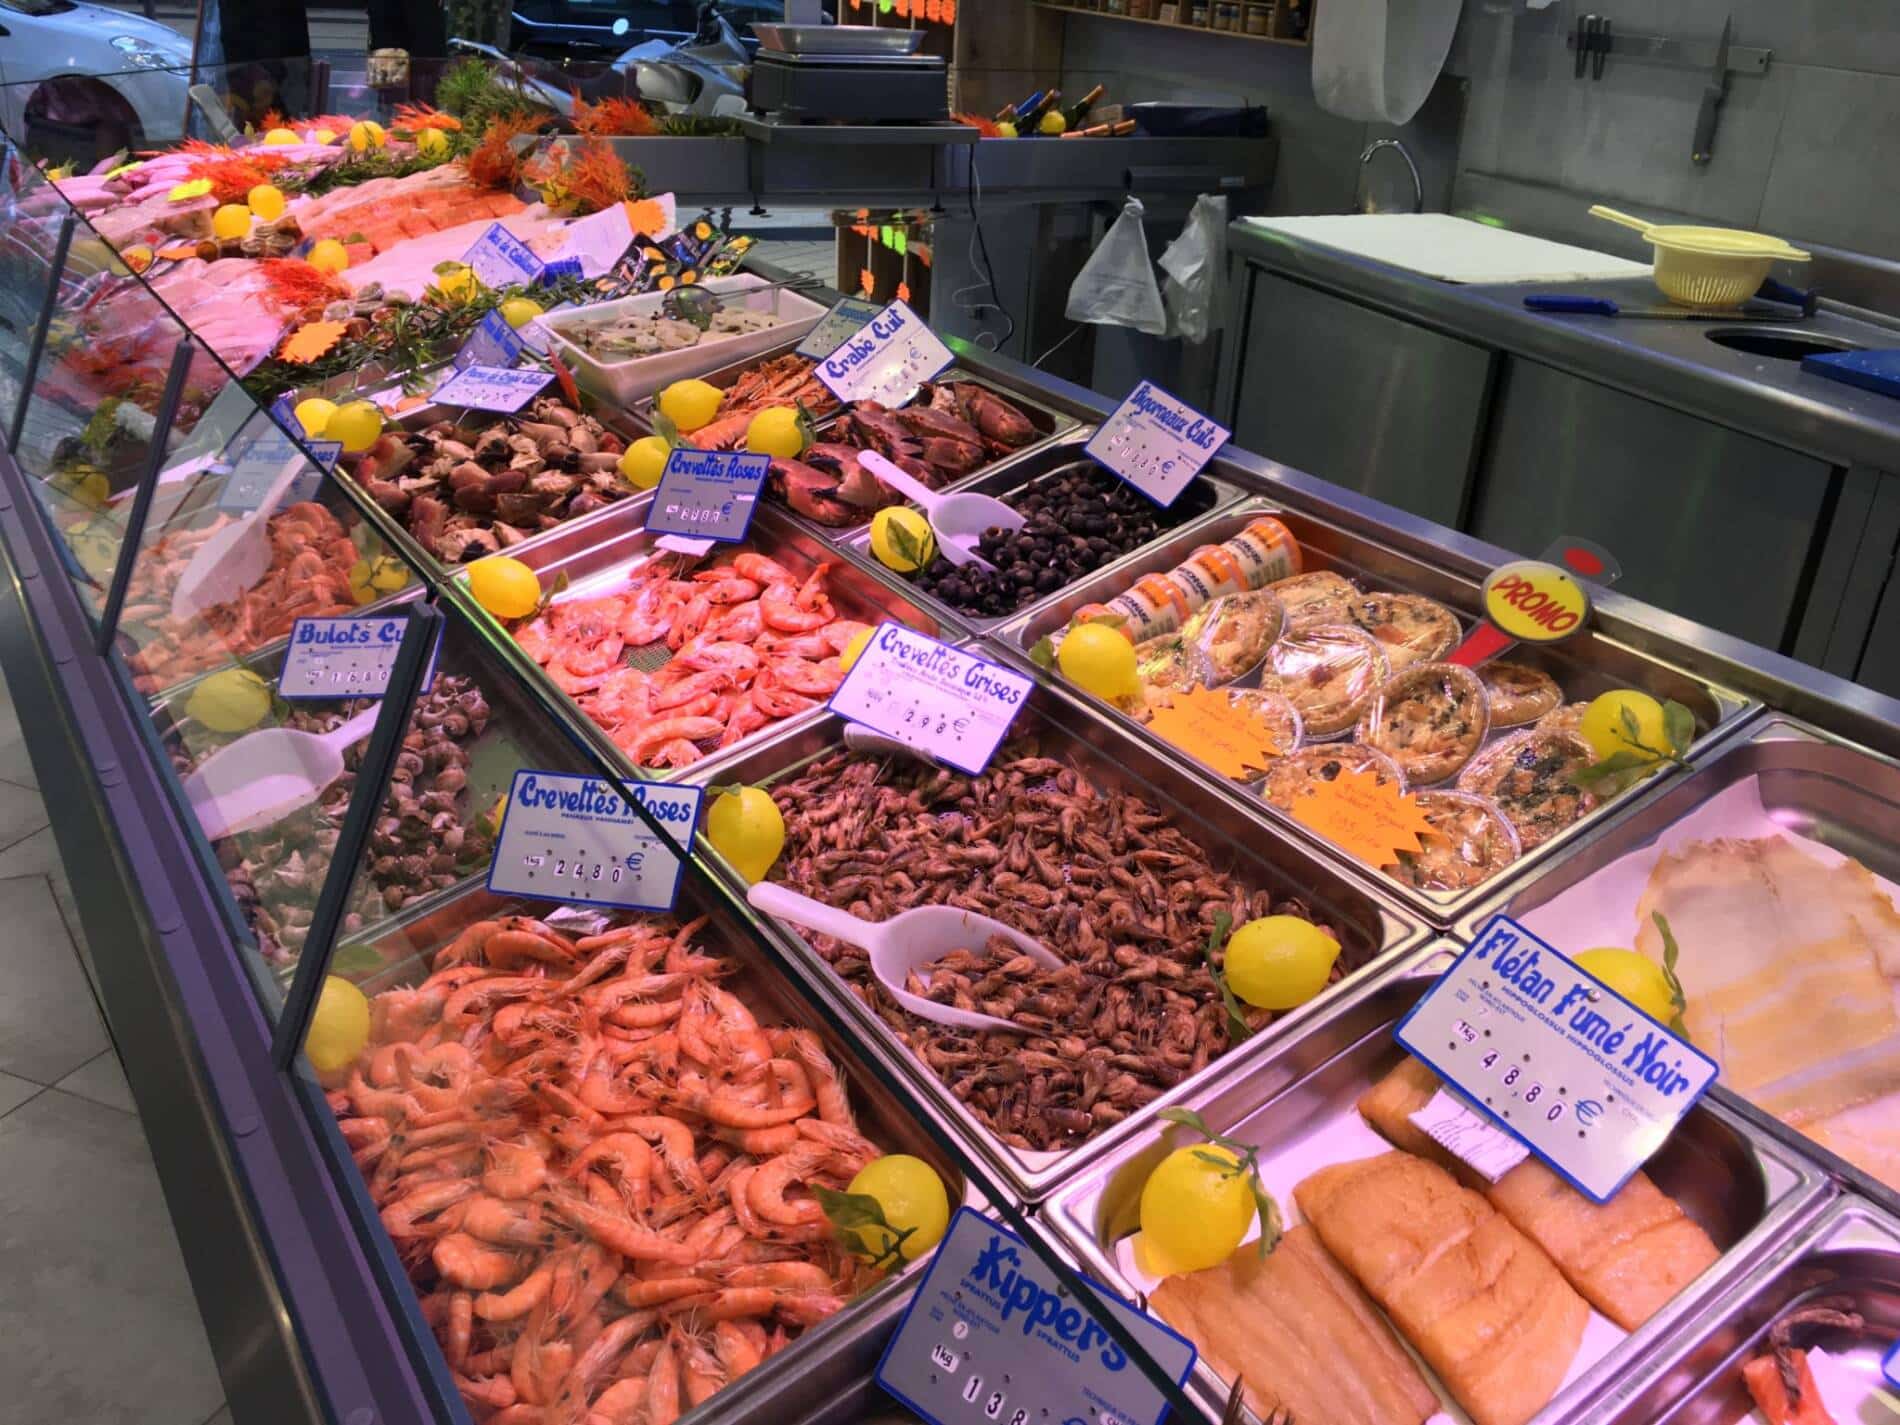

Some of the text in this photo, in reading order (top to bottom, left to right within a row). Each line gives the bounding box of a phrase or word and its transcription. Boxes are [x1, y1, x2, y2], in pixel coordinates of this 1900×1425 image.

[826, 339, 876, 378] Crabe
[872, 308, 905, 339] Cuit
[670, 452, 762, 480] Crevettes Roses
[1185, 419, 1217, 449] Cuits
[296, 622, 404, 644] Bulots Cu
[1490, 573, 1579, 632] PROMO
[880, 628, 961, 679] Crevettes
[964, 662, 1021, 705] Grises
[518, 775, 618, 815] Crevettes
[1474, 927, 1689, 1096] Flétan Fumé Noir
[1501, 985, 1635, 1087] HIPPOGLOSSUS HIPPOGLOSSUS
[1457, 1021, 1477, 1043] 1kg
[1574, 1099, 1604, 1126] €
[960, 1278, 1081, 1363] SPRATTUS SPRATTUS
[969, 1235, 1128, 1372] Kippers
[934, 1344, 954, 1367] 1kg
